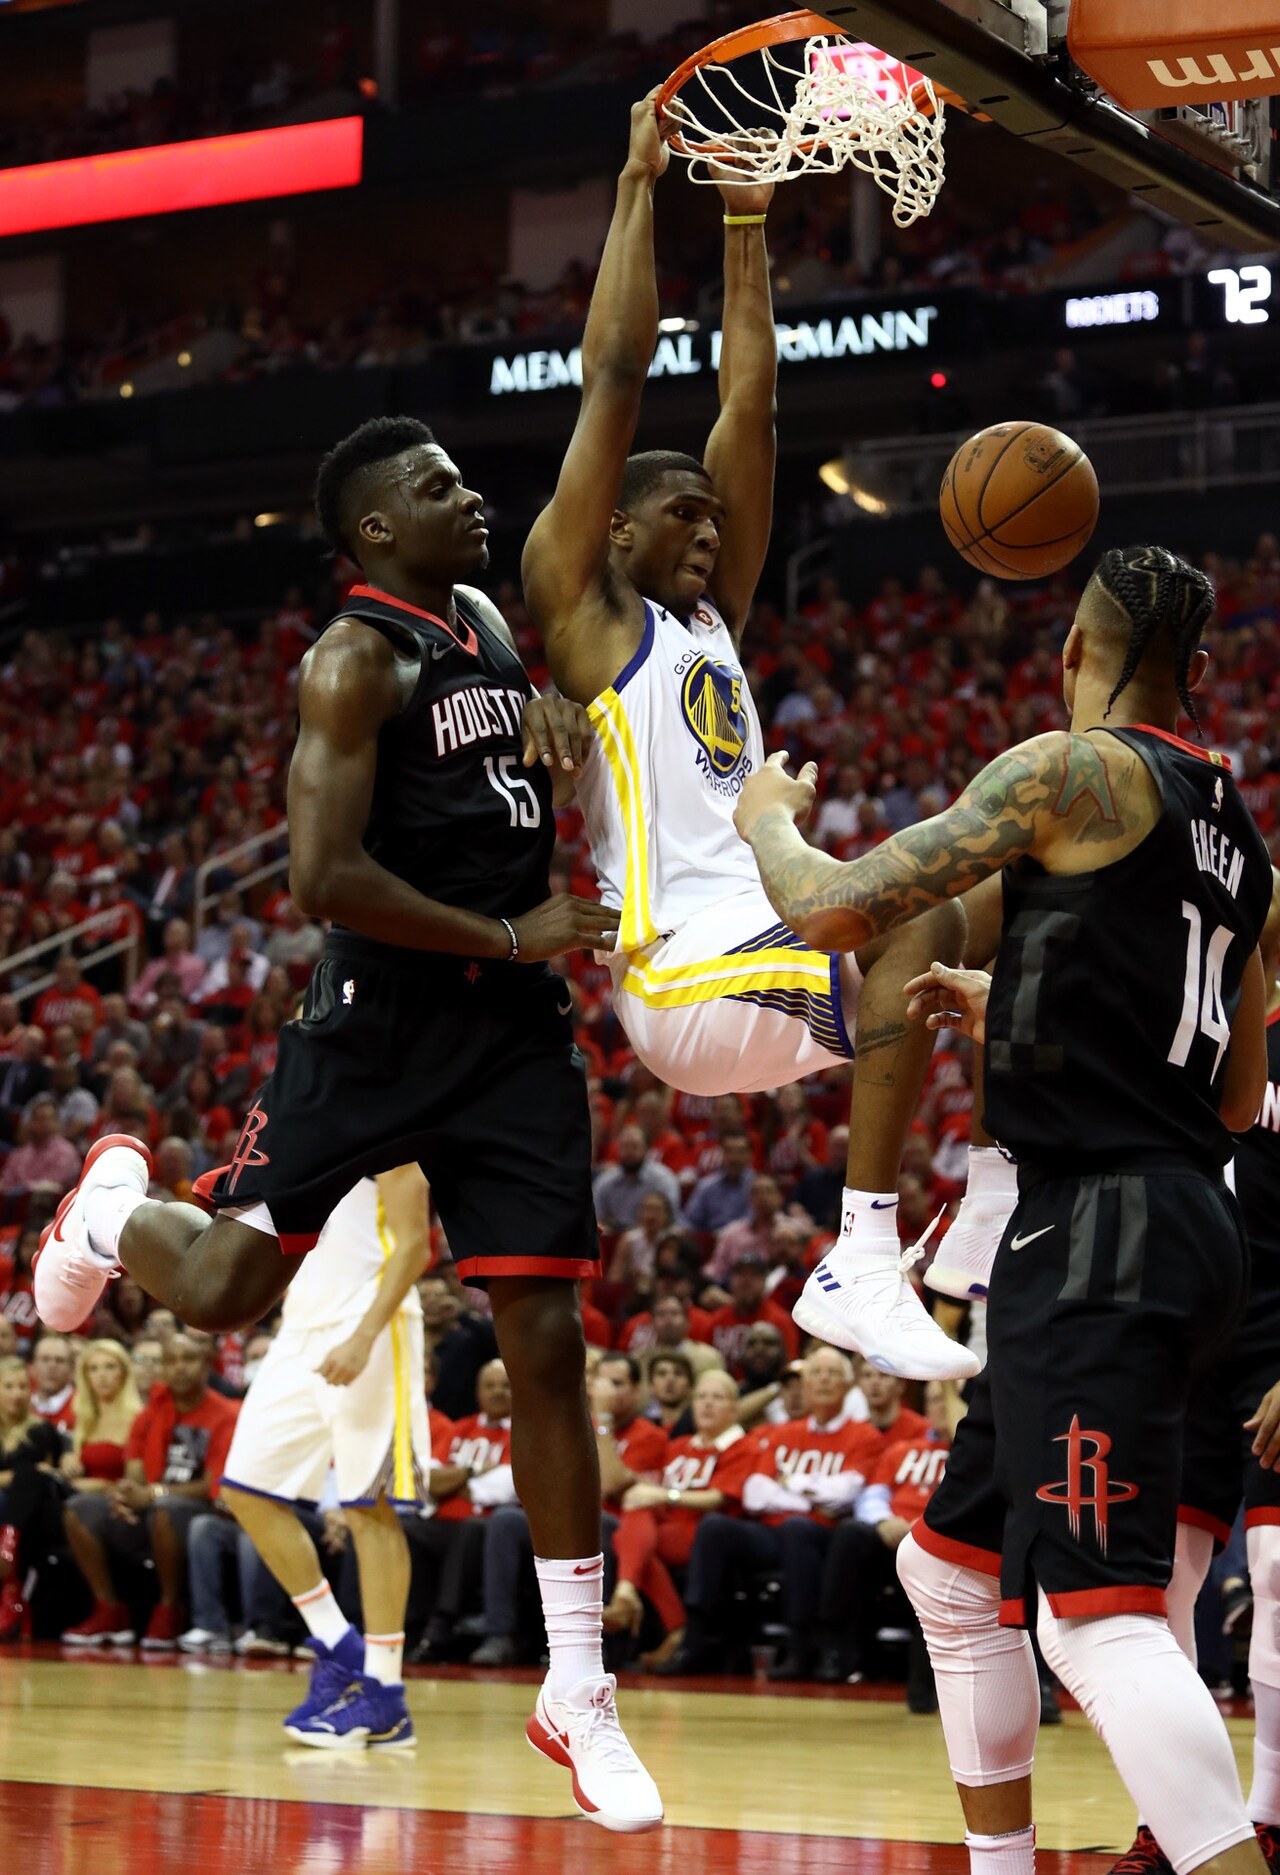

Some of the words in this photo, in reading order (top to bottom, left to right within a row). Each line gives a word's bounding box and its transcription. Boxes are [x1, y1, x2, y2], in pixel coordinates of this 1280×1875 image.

[1146, 47, 1280, 87] rm
[1207, 265, 1271, 324] 72
[489, 334, 702, 395] MEMAL
[710, 306, 930, 371] RMANN
[432, 686, 527, 757] HOUSTO
[483, 755, 541, 828] 15
[695, 748, 753, 798] WARRIORS
[1191, 819, 1245, 899] GREEN
[1167, 900, 1236, 1086] 14
[1255, 1080, 1280, 1134] N
